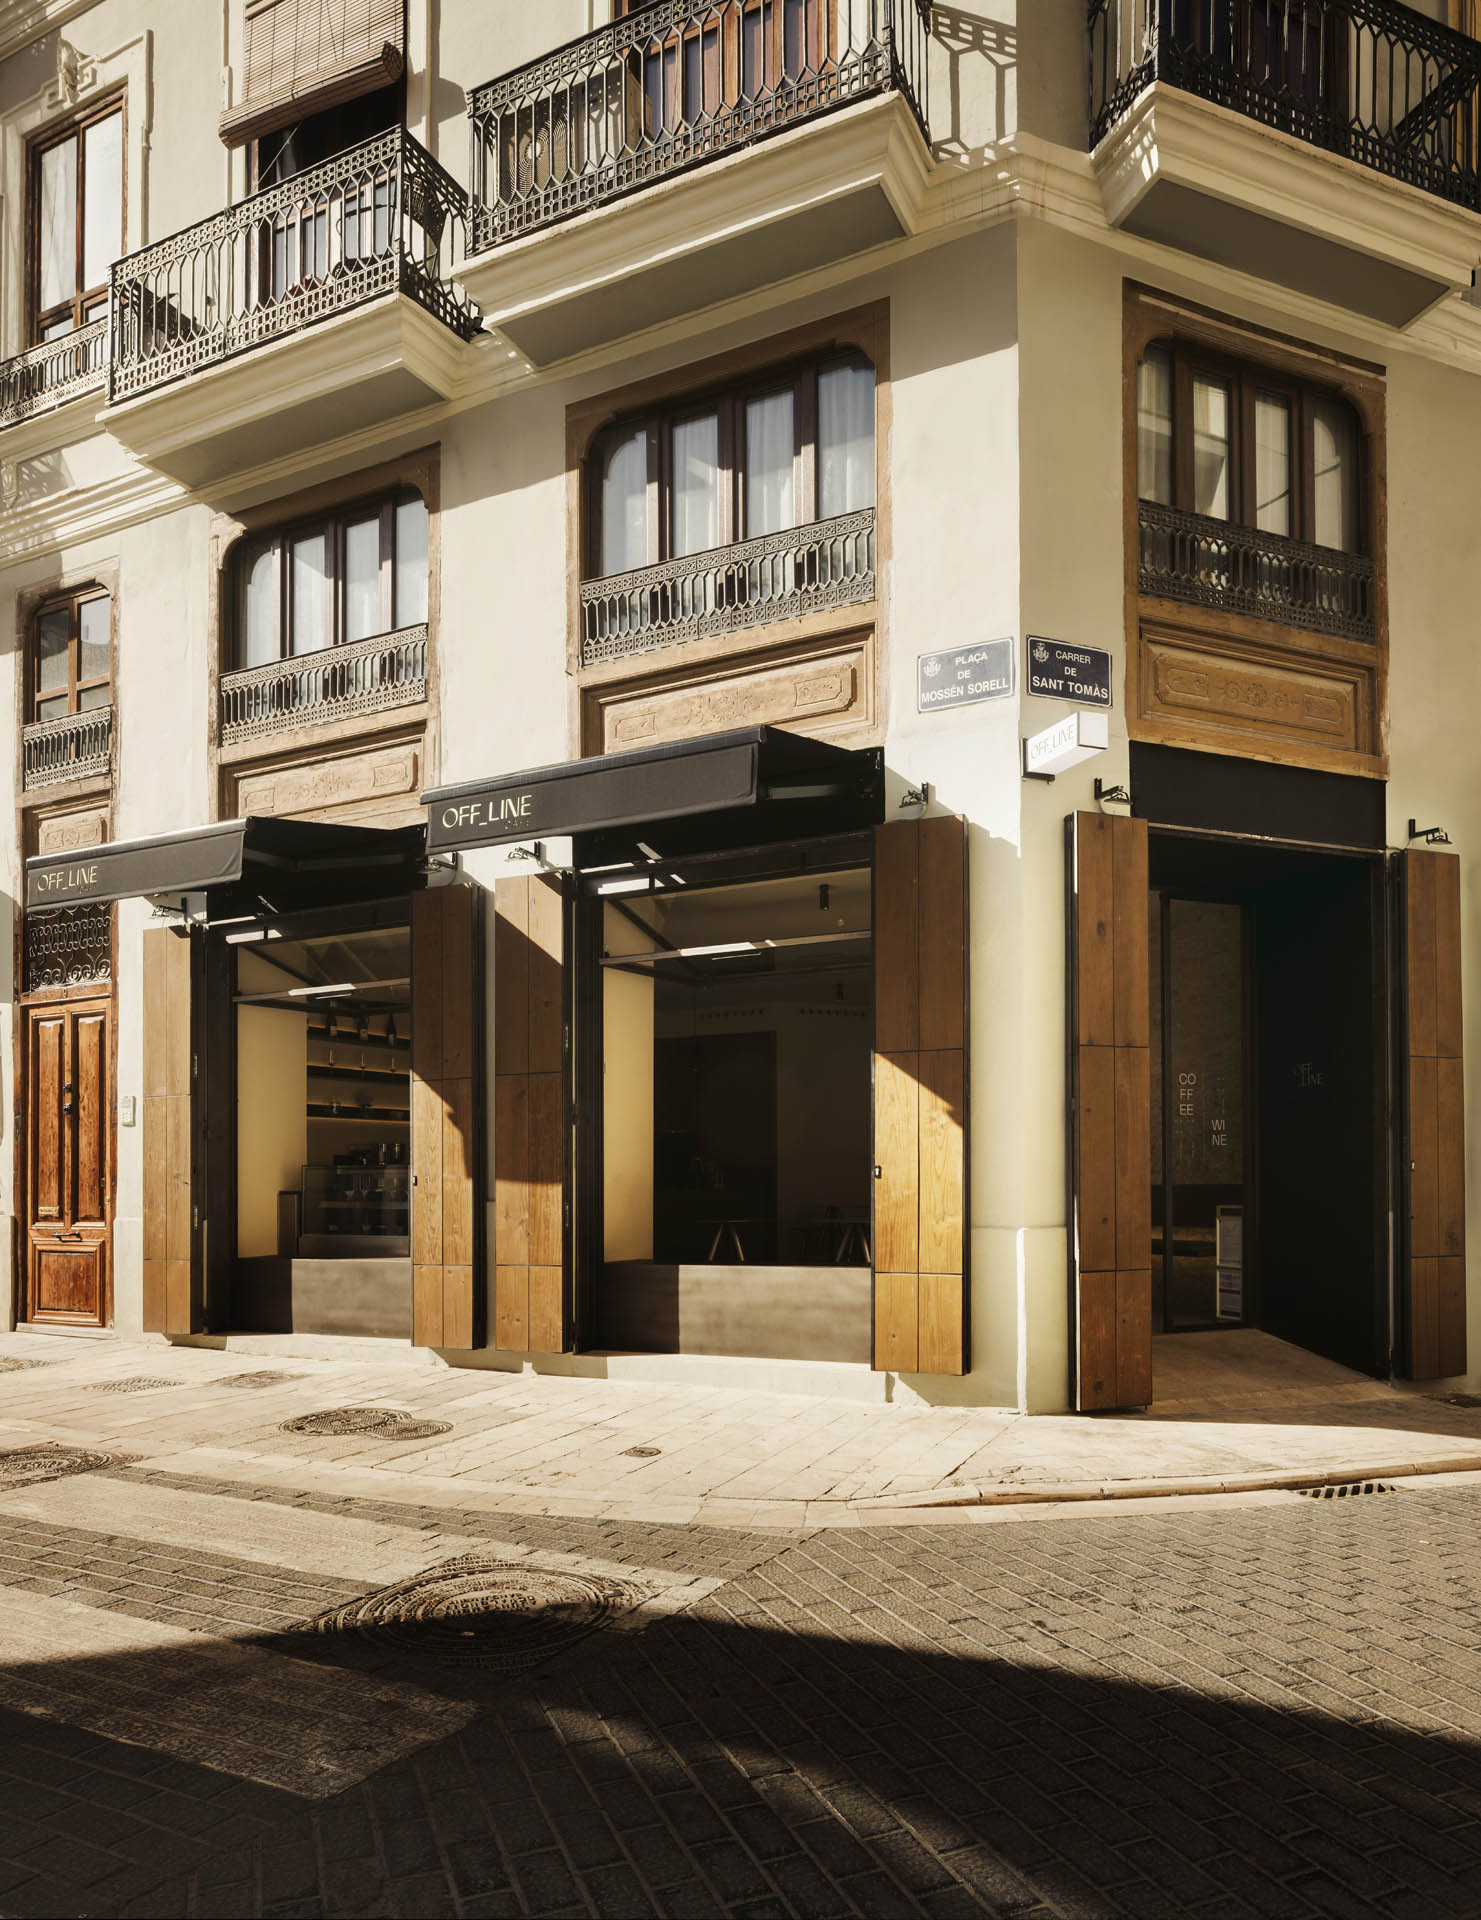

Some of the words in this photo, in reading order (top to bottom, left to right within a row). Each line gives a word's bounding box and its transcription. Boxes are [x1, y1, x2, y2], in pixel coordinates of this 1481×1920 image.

[955, 652, 988, 666] PLAÇA
[1055, 650, 1091, 664] CARRER
[957, 669, 971, 680] DE
[1064, 666, 1077, 677] DE
[967, 677, 1009, 694] SORELL
[1032, 676, 1064, 691] SANT
[1067, 681, 1108, 699] TOMÀS
[442, 794, 532, 828] OFF_LINE
[37, 865, 98, 891] OFF_LINE
